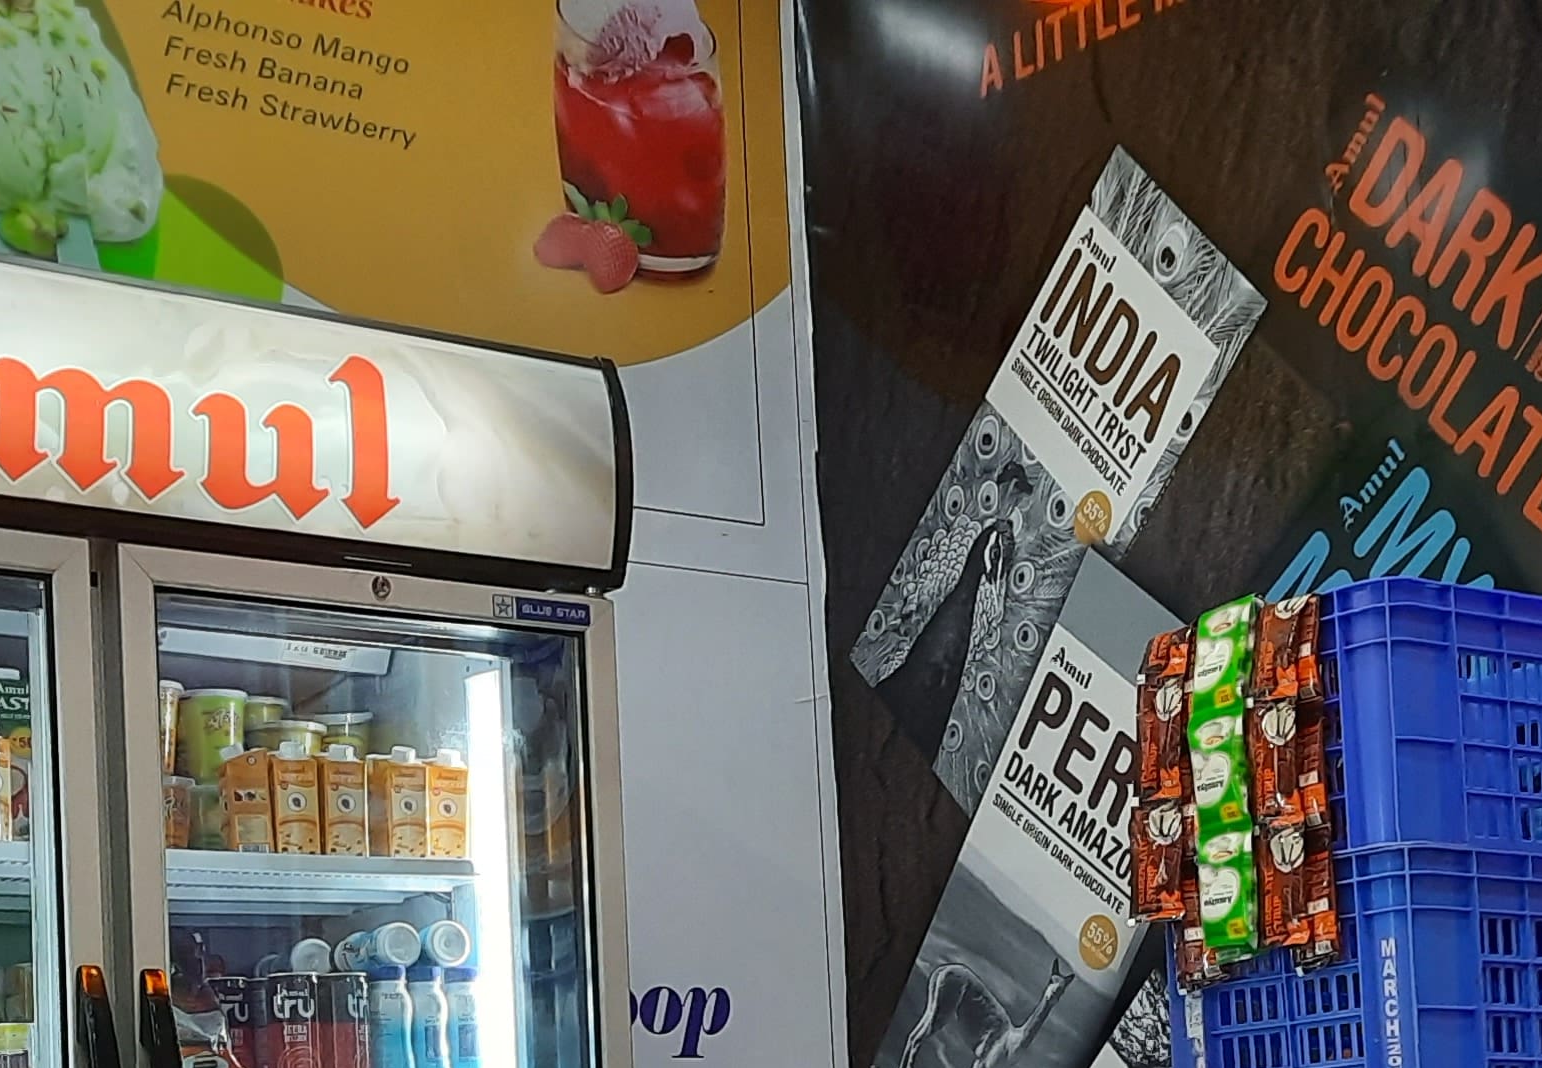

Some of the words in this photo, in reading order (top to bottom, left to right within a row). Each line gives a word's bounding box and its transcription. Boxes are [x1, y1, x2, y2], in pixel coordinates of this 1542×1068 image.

[161, 0, 303, 50] Alphonso
[312, 33, 410, 75] Mango
[163, 35, 247, 73] Fresh
[258, 57, 363, 100] Banana
[979, 42, 1004, 98] A
[1013, 0, 1142, 80] LITTLE
[165, 73, 249, 111] Fresh
[259, 94, 417, 150] Strawberry
[1324, 92, 1386, 193] Amul
[1079, 227, 1118, 274] Amul
[1039, 247, 1181, 444] INDIA
[1010, 357, 1040, 396] SINGLE
[1060, 414, 1084, 448] DARK
[1080, 438, 1127, 497] CHOCOLATE
[1024, 323, 1100, 416] TWILIGHT
[1093, 402, 1148, 470] TRYST
[1339, 438, 1407, 534] Amul
[521, 603, 552, 617] BLUE
[556, 606, 587, 620] STAR
[1051, 646, 1093, 692] Amul
[1018, 671, 1139, 828] PER
[992, 793, 1023, 826] SINGLE
[1050, 844, 1074, 873] DARK
[1073, 865, 1124, 915] CHOCOLATE
[1004, 751, 1061, 819] DARK
[1058, 801, 1133, 889] AMAZO
[1087, 920, 1114, 957] 55%
[630, 984, 732, 1060] op
